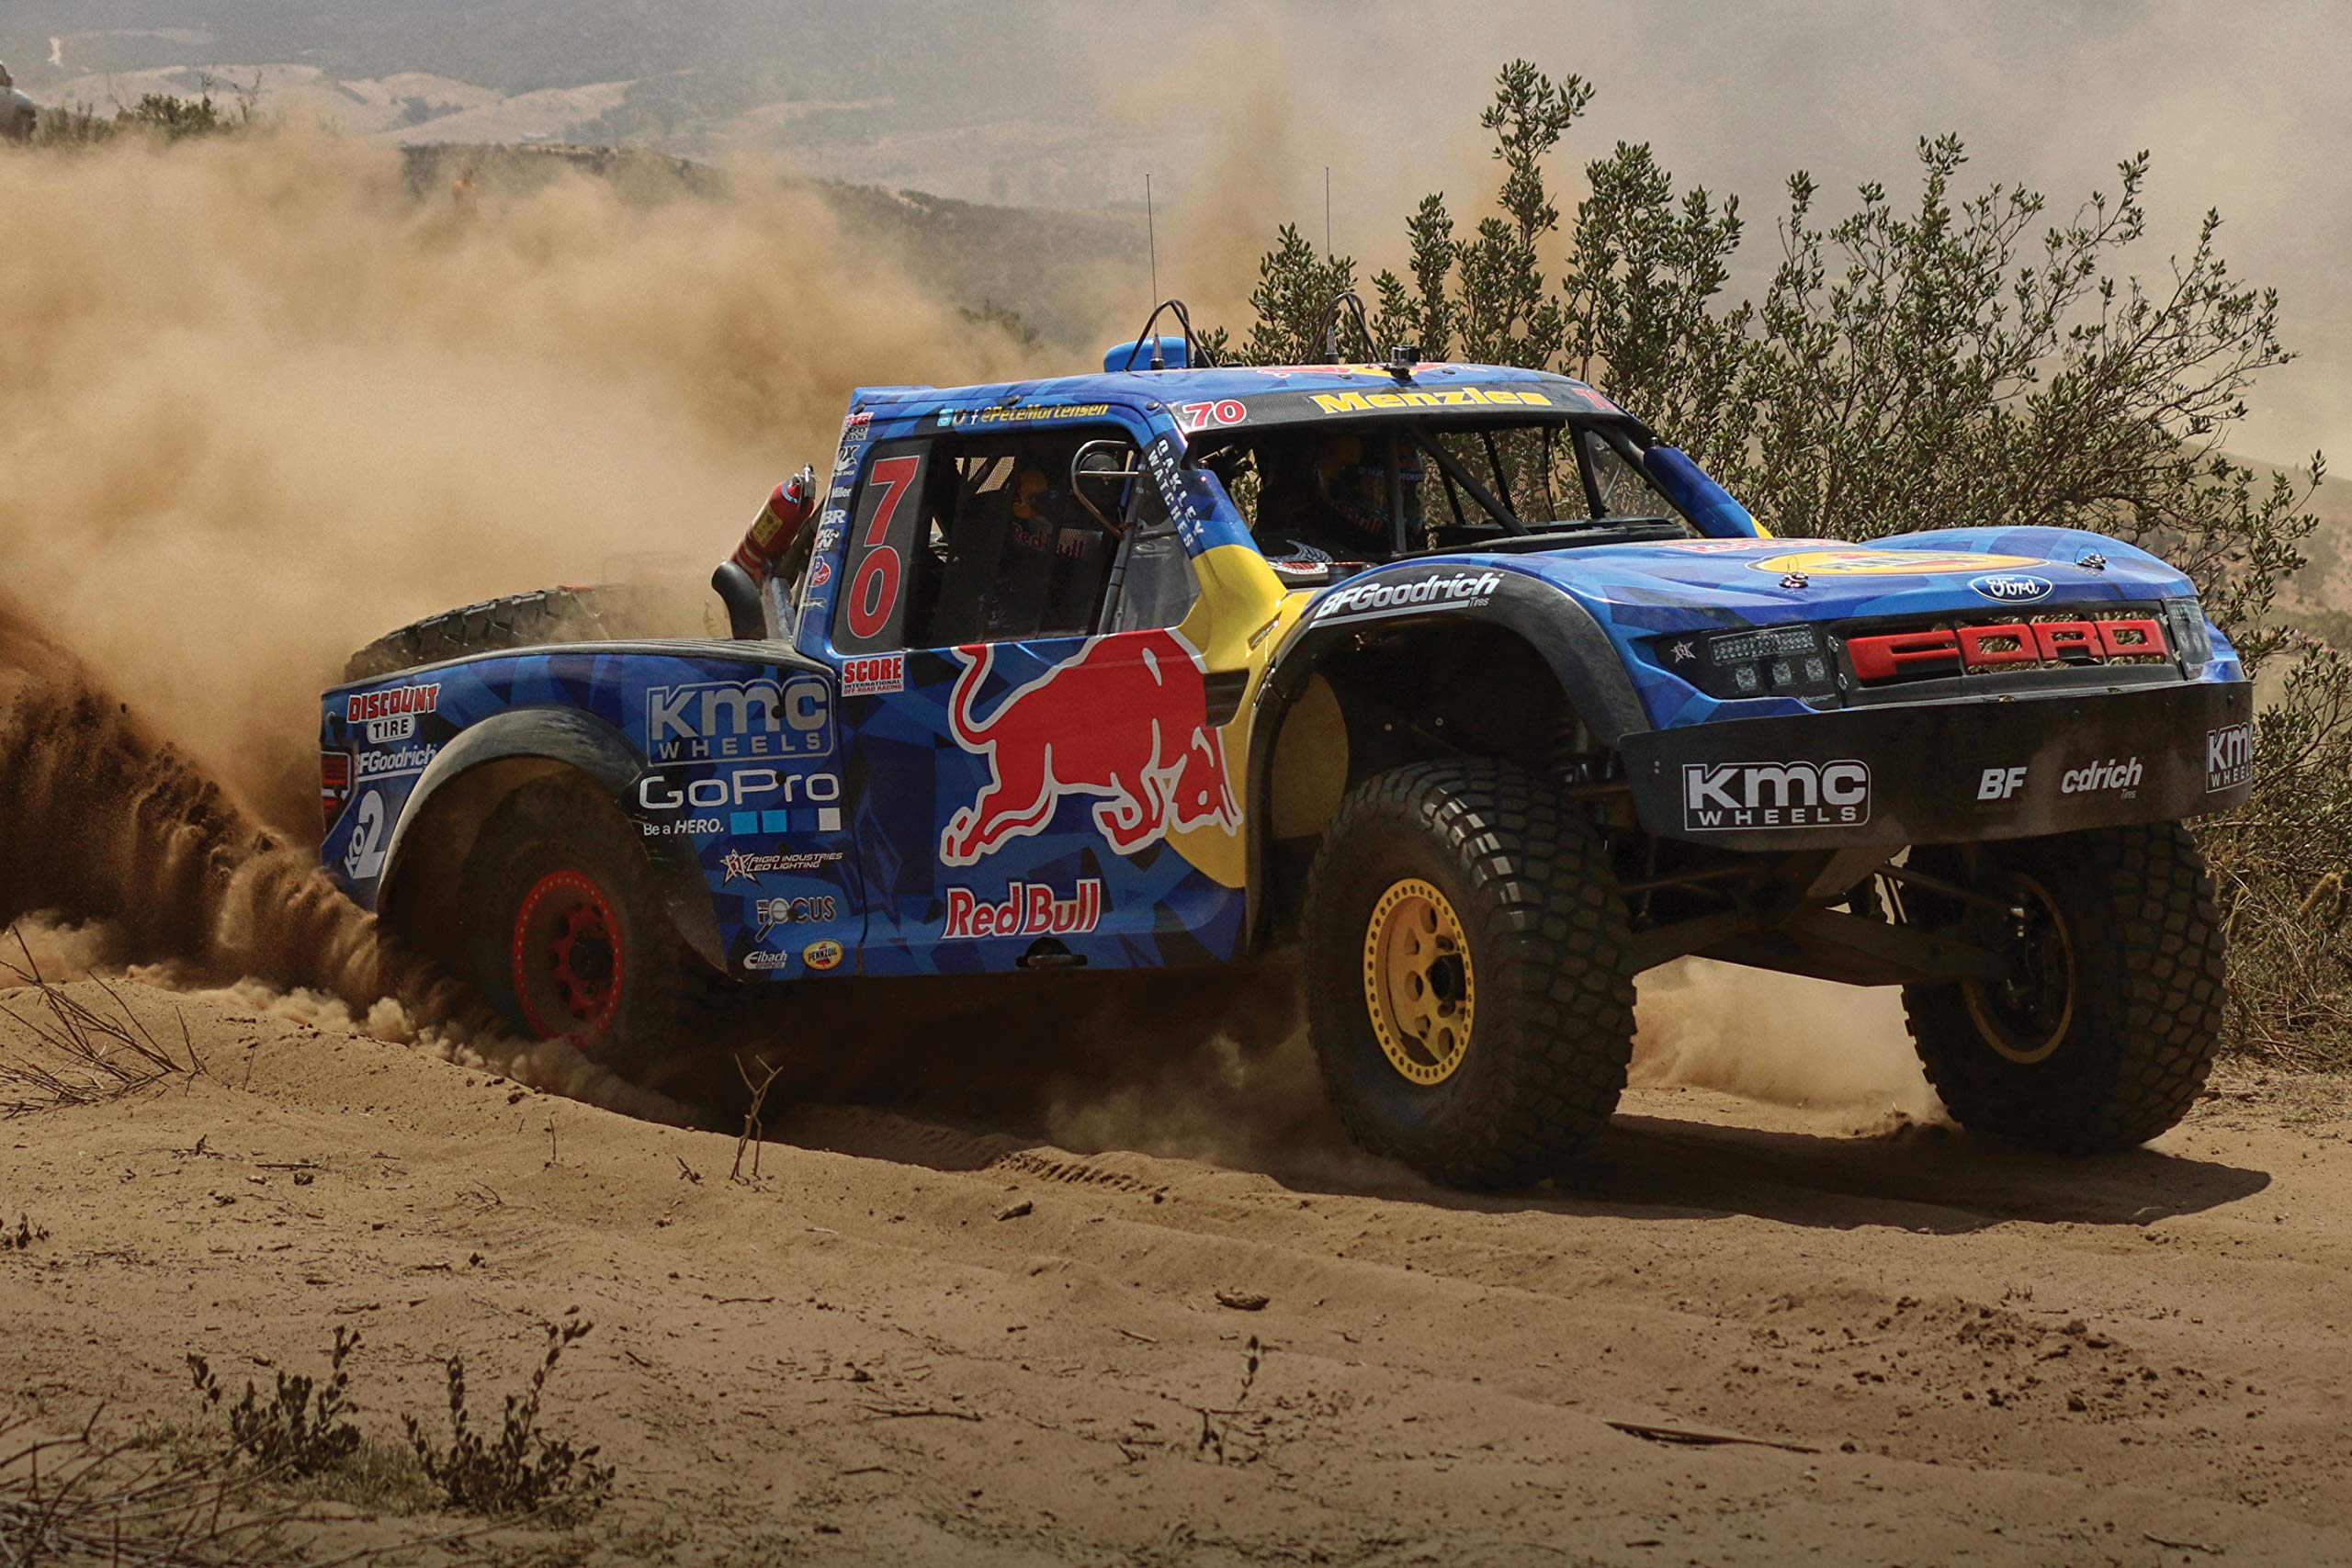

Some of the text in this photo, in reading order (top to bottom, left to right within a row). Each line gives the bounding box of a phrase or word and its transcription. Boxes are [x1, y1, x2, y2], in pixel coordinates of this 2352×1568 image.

[1182, 399, 1247, 428] 70
[1148, 449, 1194, 548] WATCHES
[1158, 439, 1204, 536] OAKLEY
[1313, 572, 1501, 619] BFGoodrich
[1987, 574, 2041, 598] Ford
[1846, 619, 2170, 681] FORD
[844, 658, 902, 683] SCORE
[347, 684, 439, 723] DISCOUNT
[373, 718, 409, 739] TIRE
[659, 732, 821, 760] WHEELS
[639, 769, 840, 809] GoPro
[1977, 766, 2028, 800] BF
[644, 818, 725, 836] Be a HERO.
[1698, 807, 1857, 826] WHEELS
[752, 852, 843, 863] RIGID INDUSTRIES
[773, 862, 820, 871] LIGHTING
[943, 879, 1101, 938] Red Bull
[743, 950, 787, 969] Eibach
[808, 947, 838, 962] PENNZOIL
